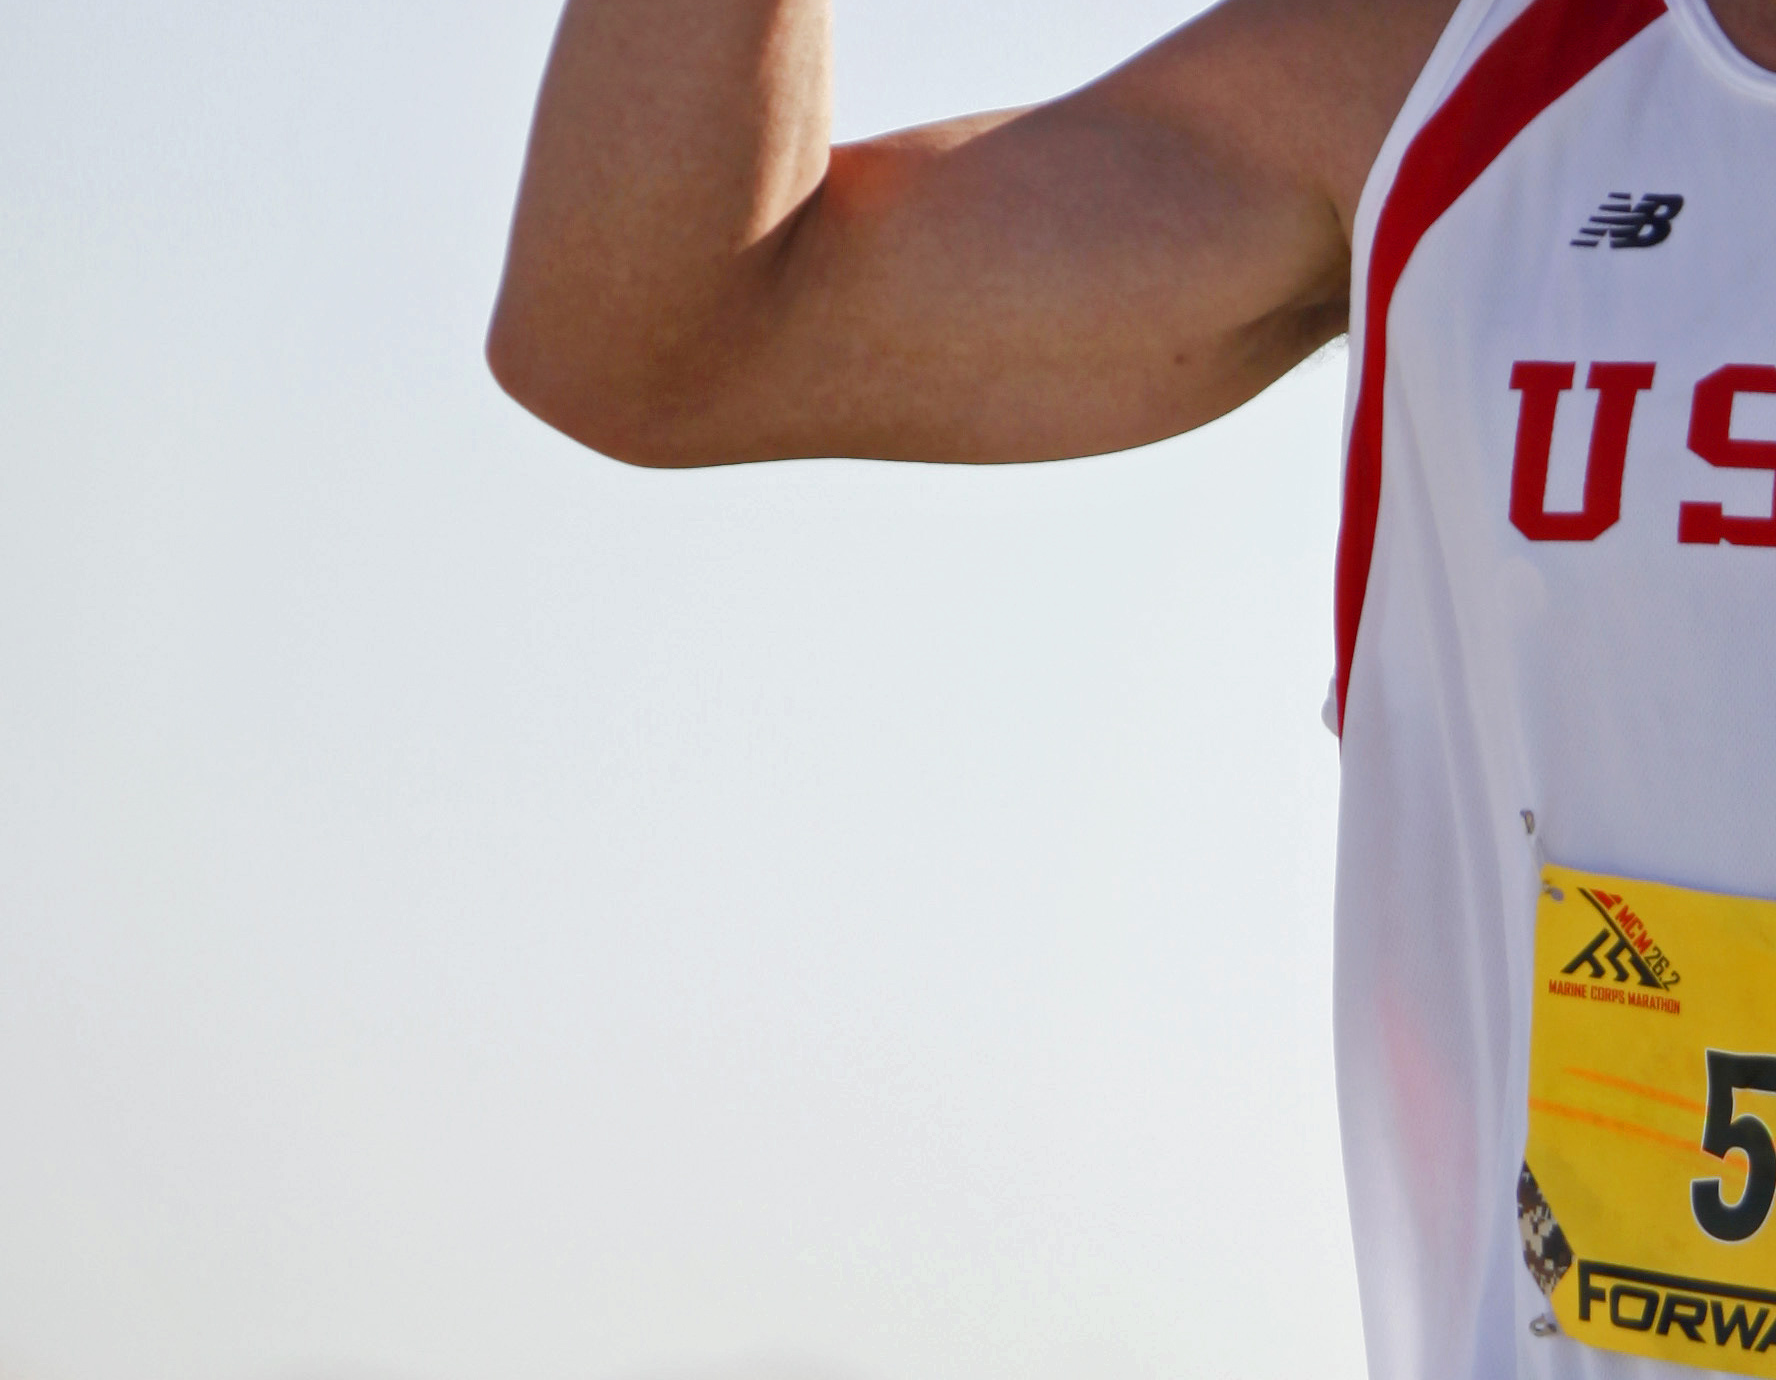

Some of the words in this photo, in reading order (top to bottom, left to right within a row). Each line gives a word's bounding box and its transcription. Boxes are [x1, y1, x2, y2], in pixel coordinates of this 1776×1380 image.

[1614, 905, 1653, 956] MCM
[1644, 946, 1682, 992] 26.2
[1548, 978, 1588, 999] MARINE
[1590, 985, 1626, 1005] CORPS
[1627, 991, 1681, 1016] MARATHON
